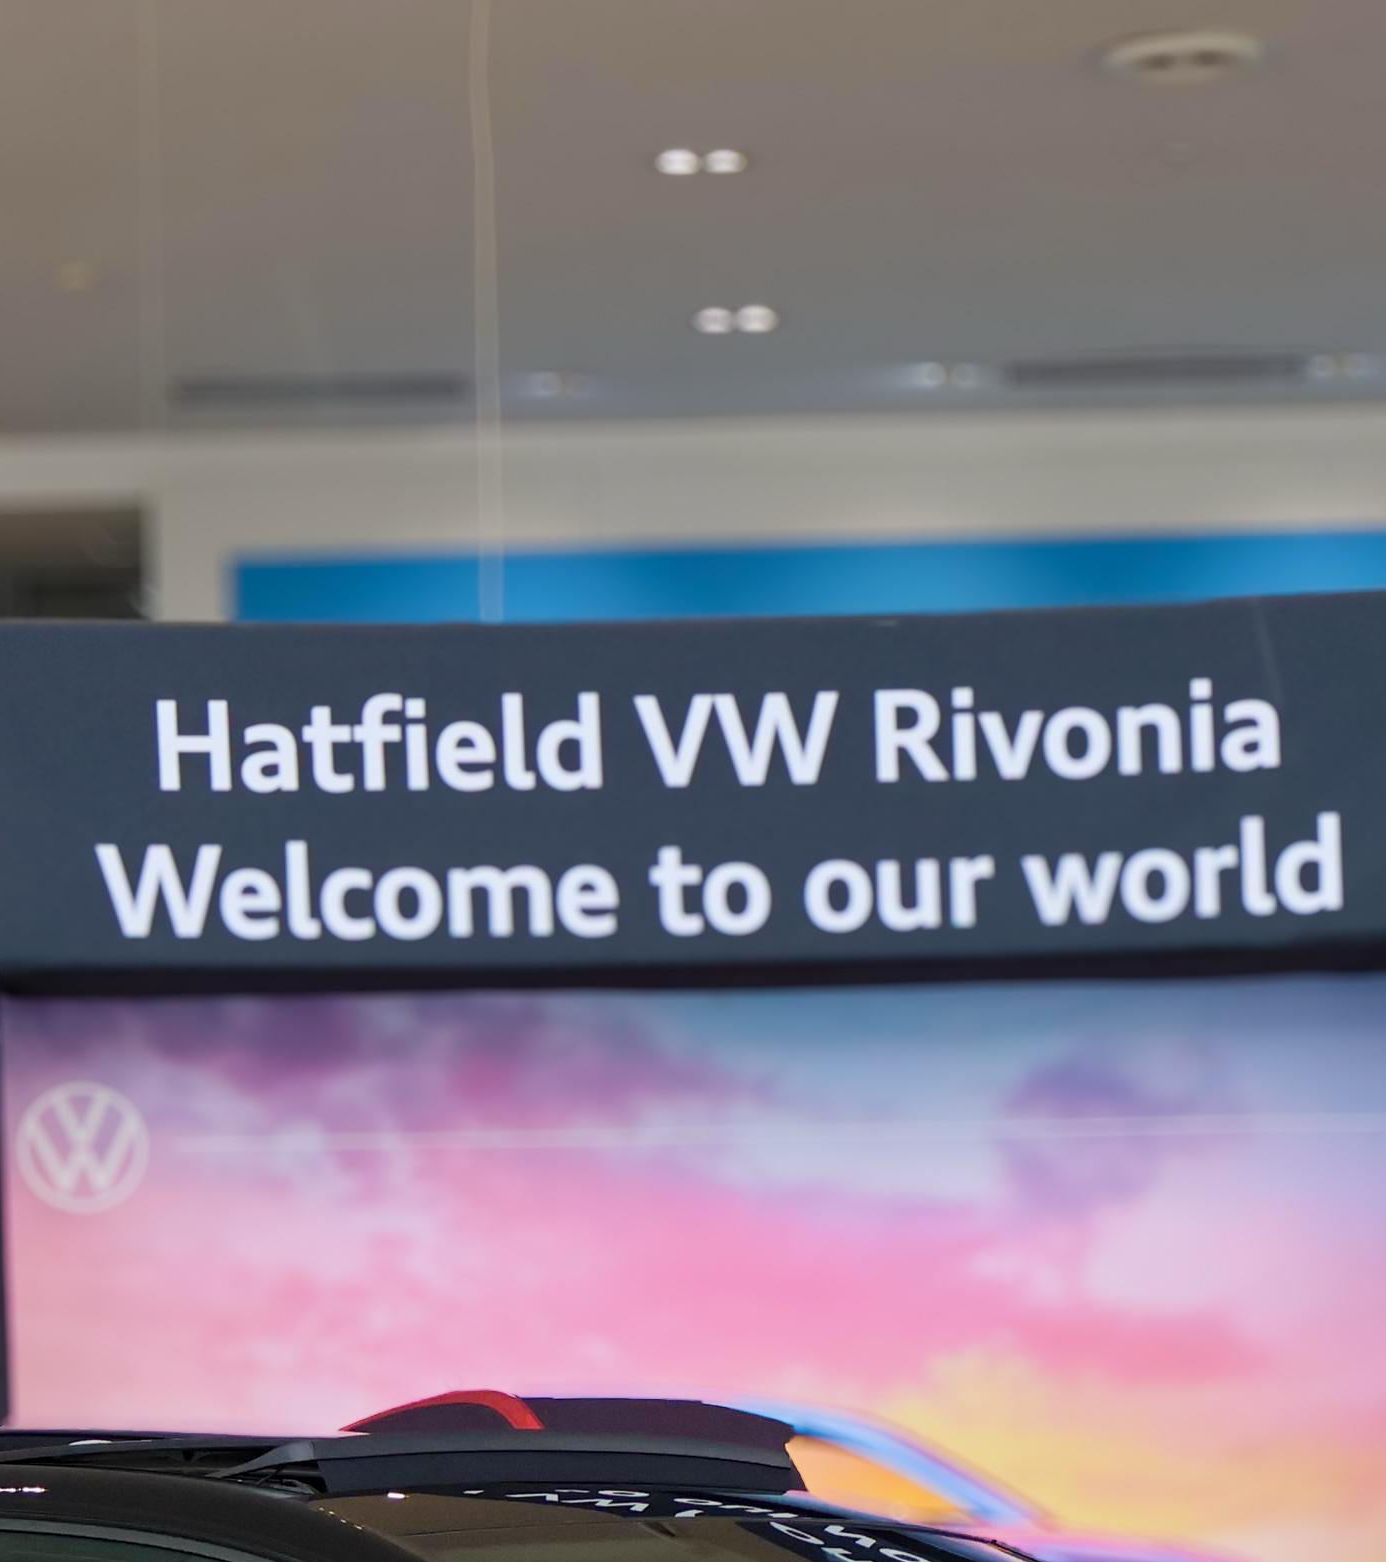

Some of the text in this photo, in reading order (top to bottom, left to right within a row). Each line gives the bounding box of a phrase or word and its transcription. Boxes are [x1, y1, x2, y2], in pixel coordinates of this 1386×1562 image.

[156, 677, 1281, 793] Hatfield VW Rivonia
[96, 812, 1343, 940] Welcome to our world
